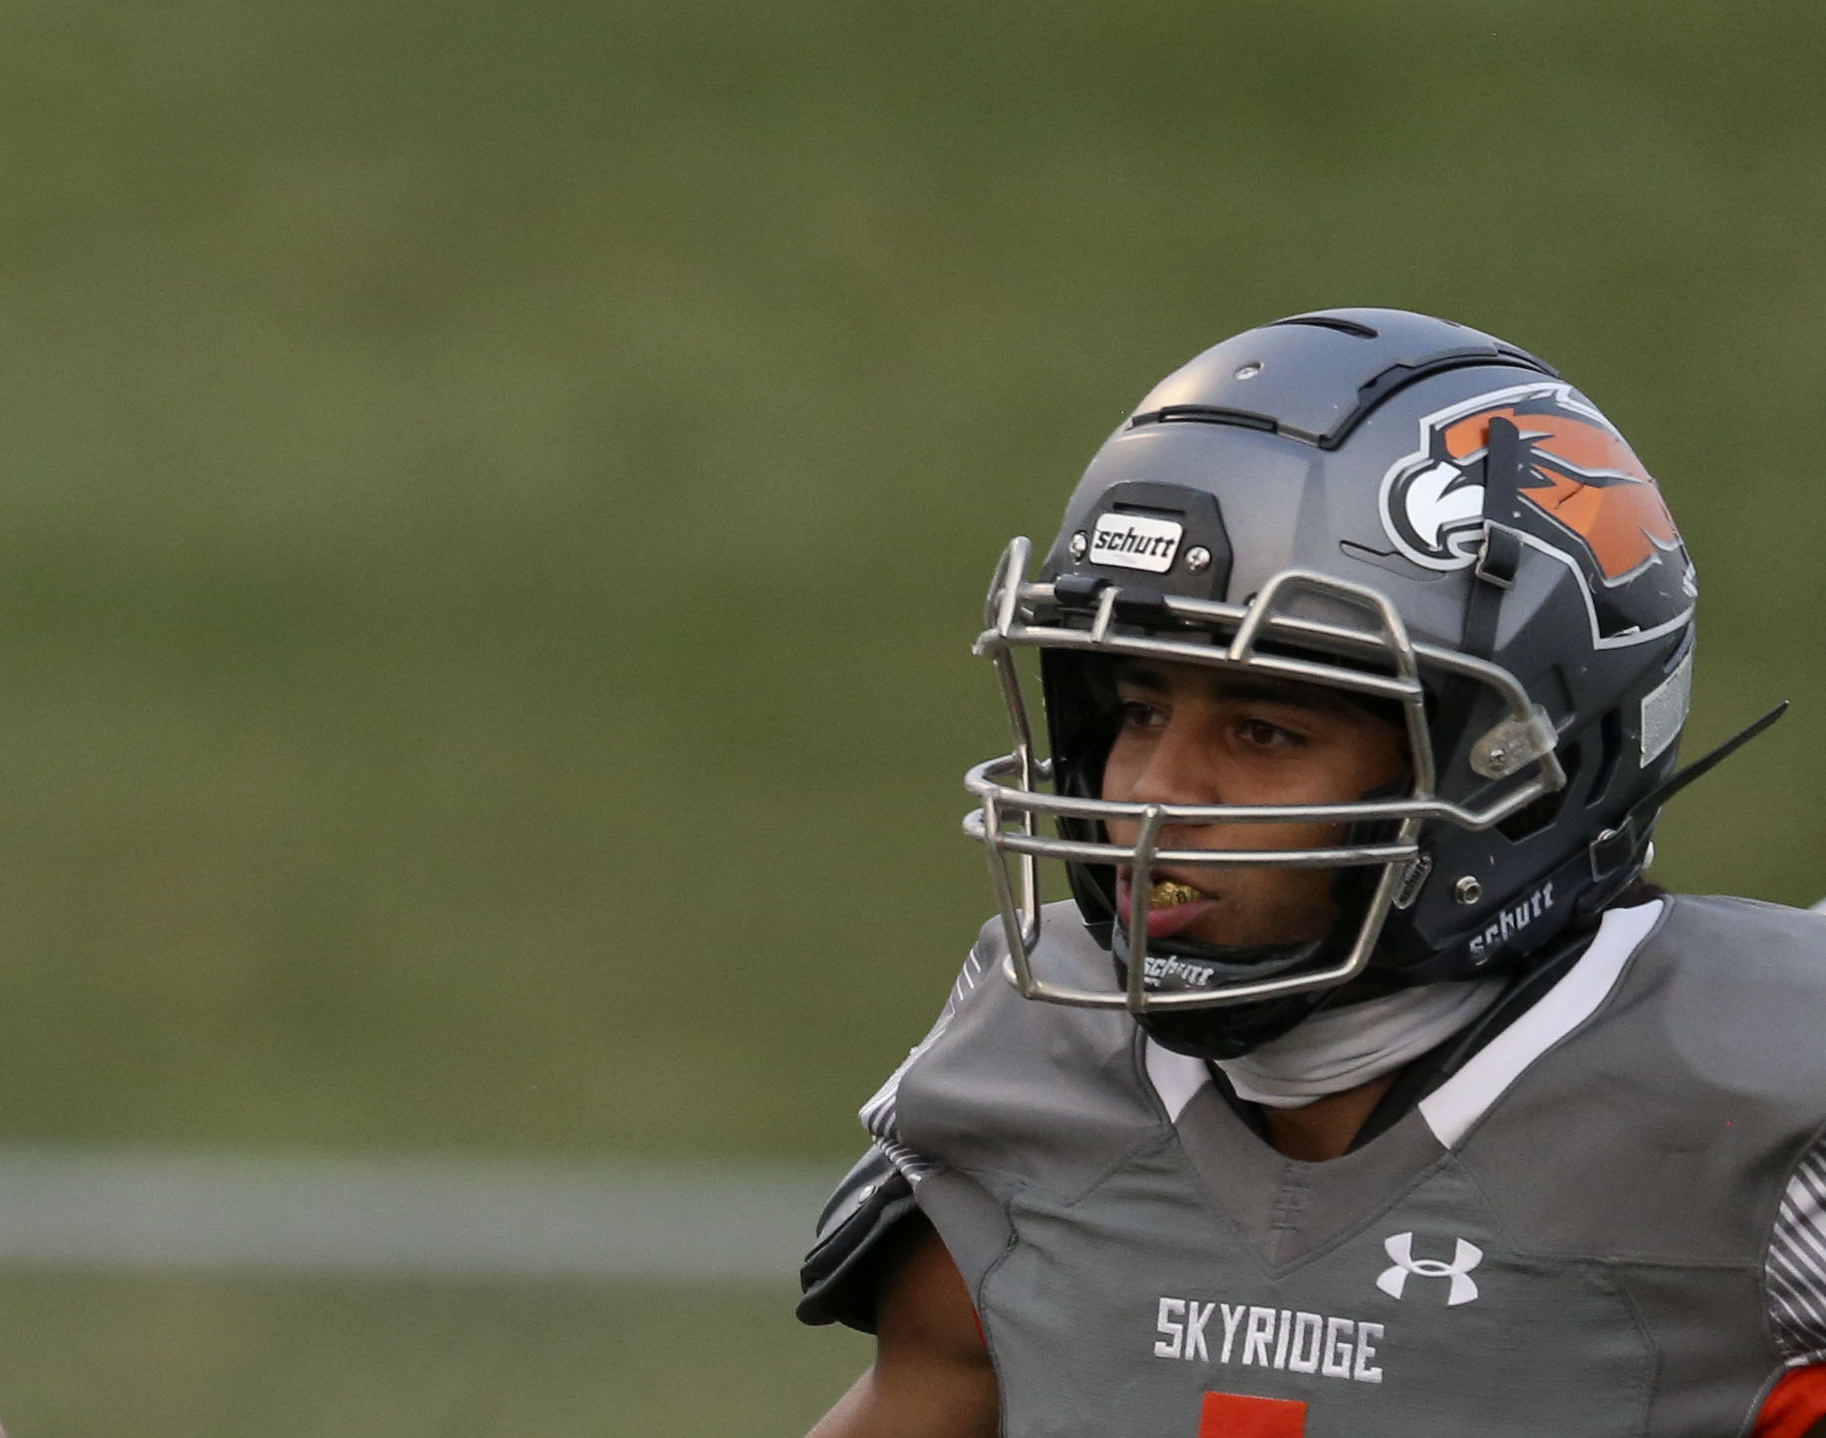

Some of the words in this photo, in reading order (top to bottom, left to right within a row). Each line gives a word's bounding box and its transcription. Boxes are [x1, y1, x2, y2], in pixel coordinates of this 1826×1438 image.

[1094, 526, 1175, 558] schutt
[1469, 880, 1556, 960] schutt
[1154, 1297, 1385, 1383] SKYRIDGE
